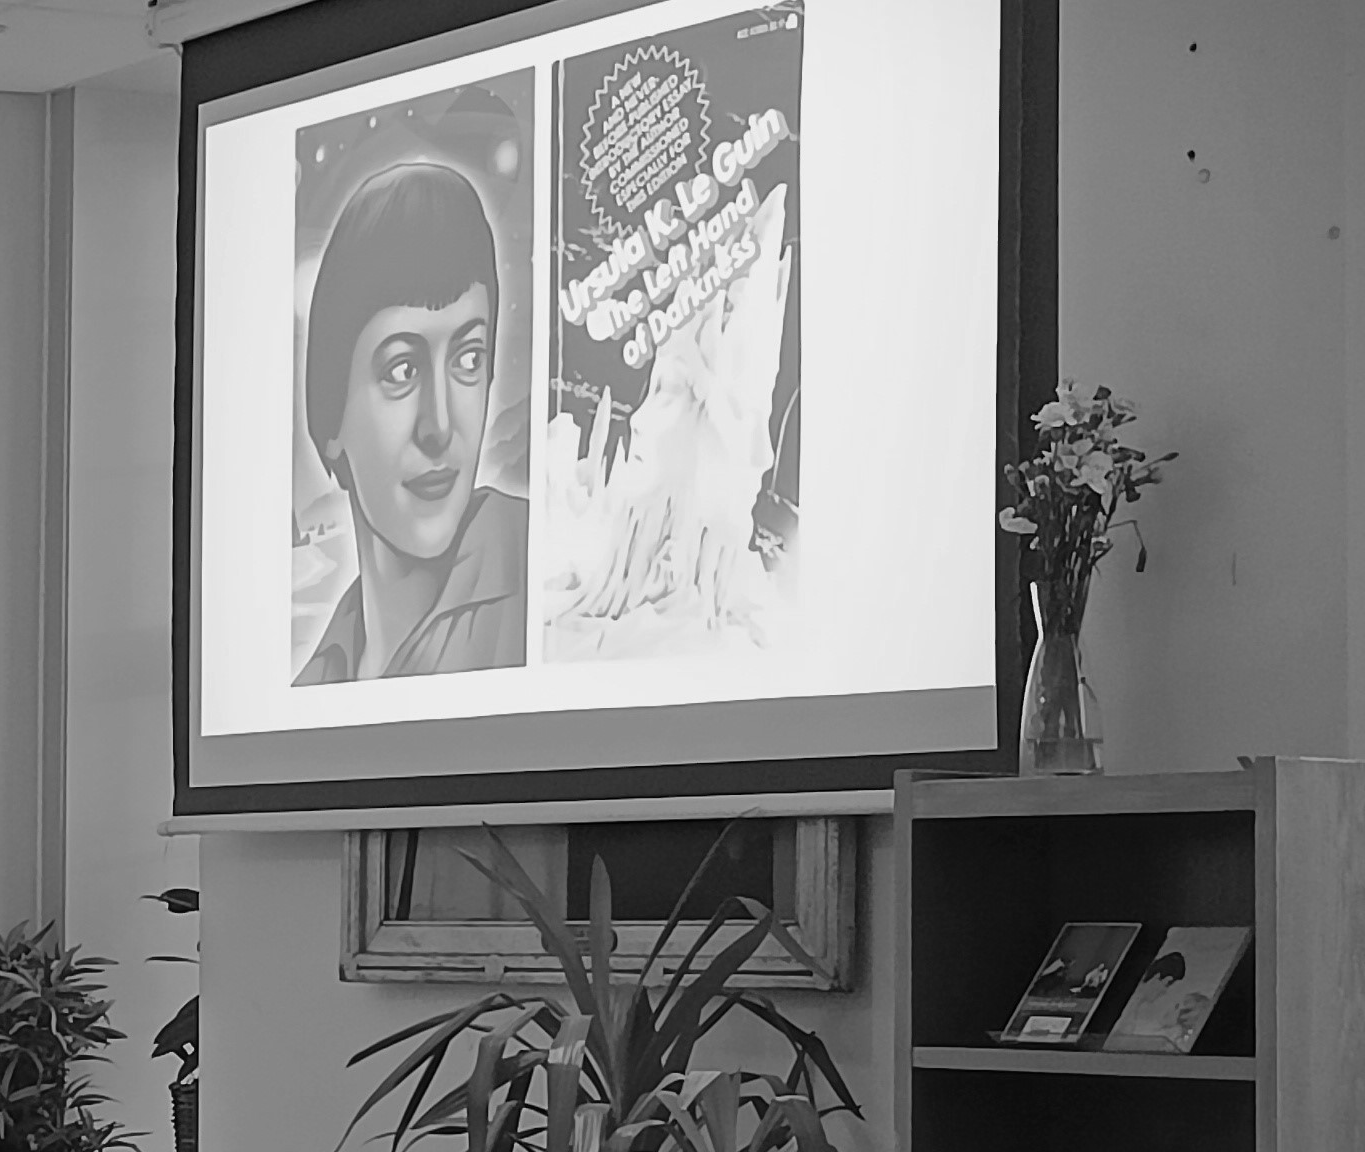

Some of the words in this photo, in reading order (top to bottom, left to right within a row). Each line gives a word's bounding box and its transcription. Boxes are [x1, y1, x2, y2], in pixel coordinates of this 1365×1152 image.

[558, 230, 649, 325] Ursula
[674, 172, 715, 222] Le
[711, 107, 786, 186] Guin
[687, 177, 757, 252] Hand
[622, 321, 651, 368] of
[647, 231, 759, 346] Darkness
